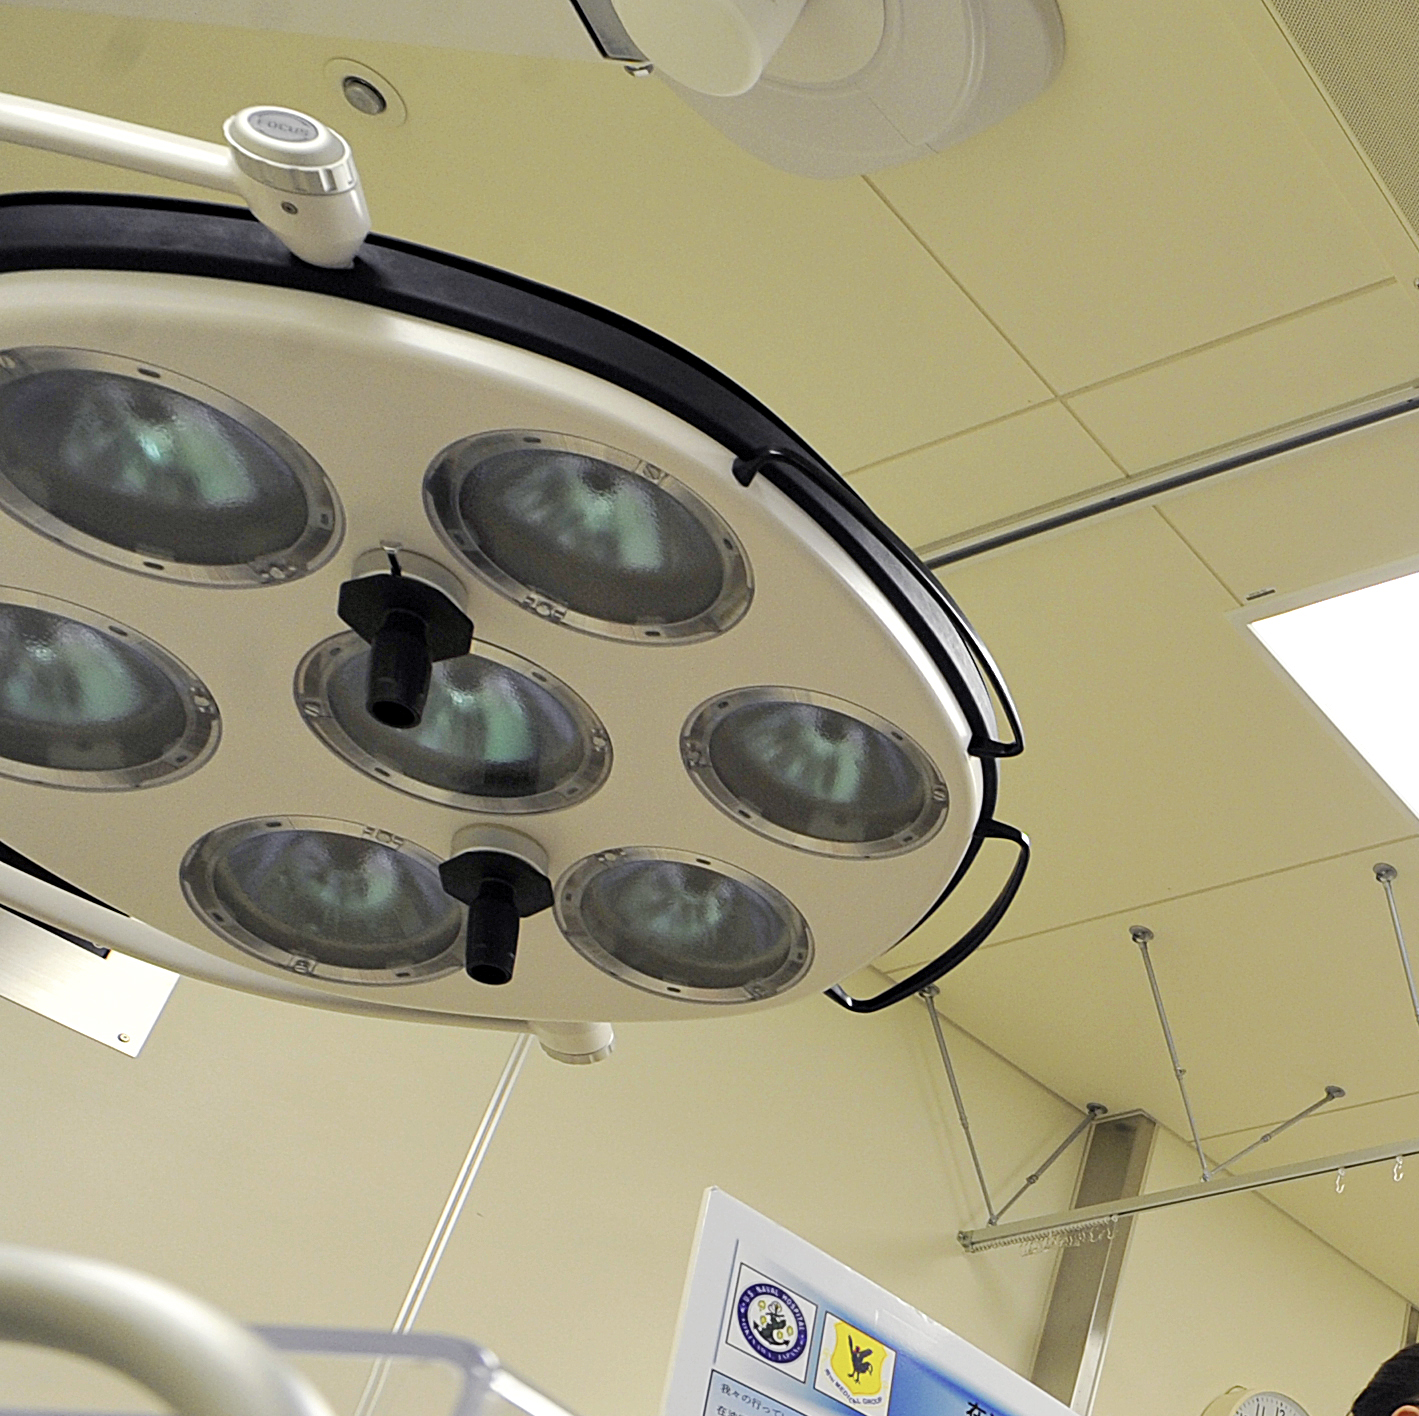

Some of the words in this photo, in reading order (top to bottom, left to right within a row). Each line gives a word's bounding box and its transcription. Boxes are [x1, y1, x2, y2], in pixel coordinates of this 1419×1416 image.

[257, 117, 309, 137] FOCUS
[781, 1293, 805, 1330] HOSPITAL
[835, 1381, 861, 1404] MEDICAL
[862, 1396, 882, 1405] GROUP
